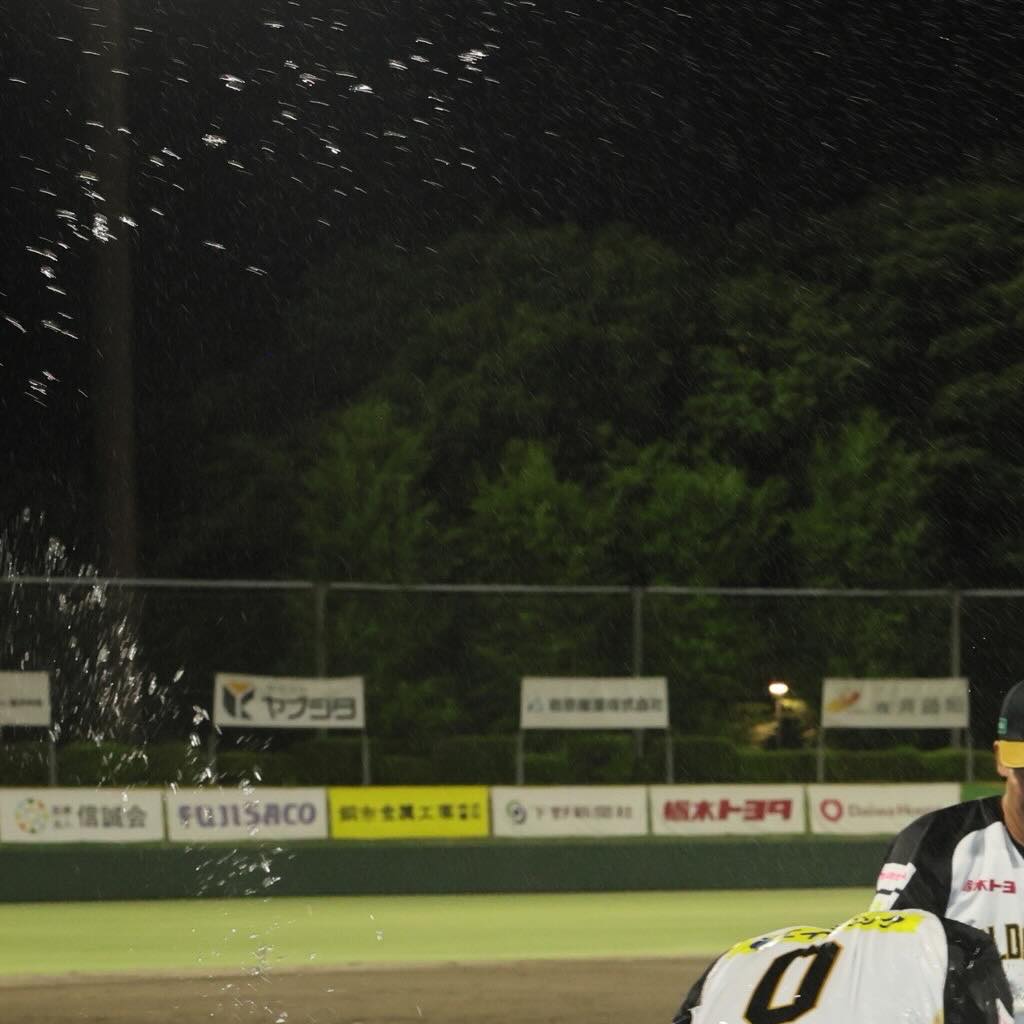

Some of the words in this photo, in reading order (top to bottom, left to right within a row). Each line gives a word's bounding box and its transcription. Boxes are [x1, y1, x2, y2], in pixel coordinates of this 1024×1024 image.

[664, 799, 793, 821] 栃木トヨタ
